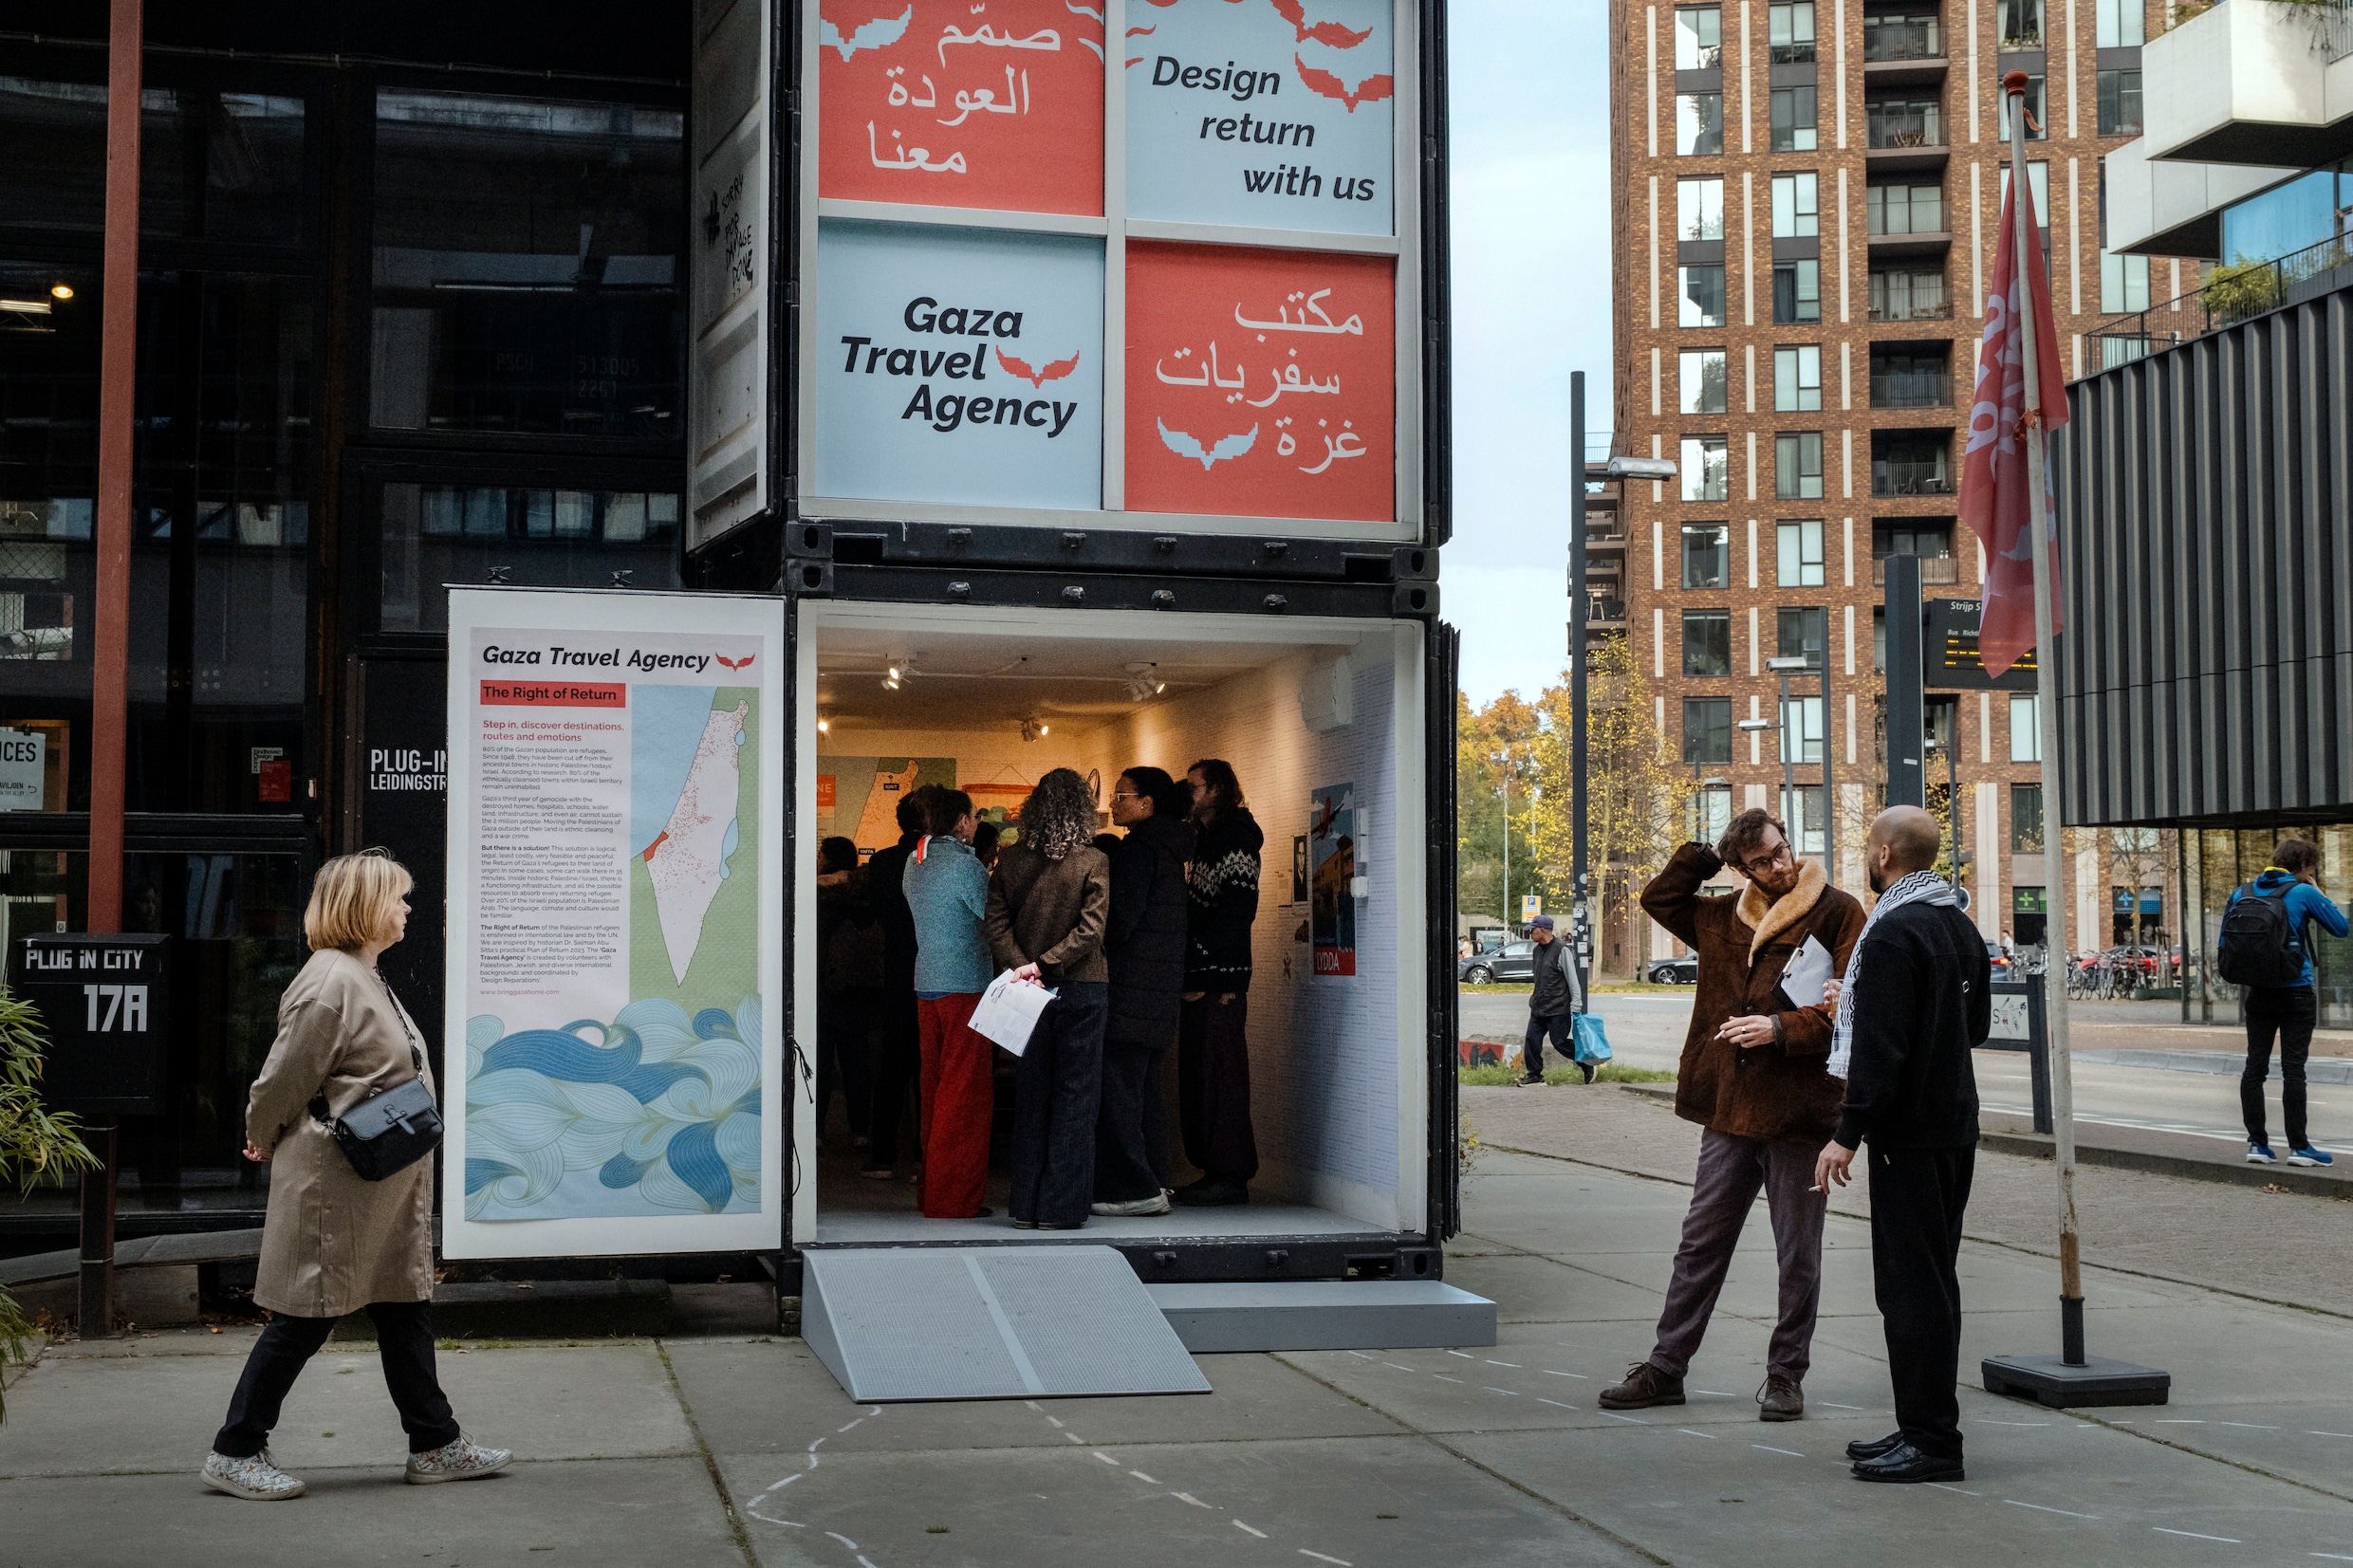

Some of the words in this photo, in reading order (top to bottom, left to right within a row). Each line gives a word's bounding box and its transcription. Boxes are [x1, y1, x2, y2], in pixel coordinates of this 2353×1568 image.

[1153, 56, 1281, 101] Design
[868, 121, 967, 175] معنا
[1200, 113, 1315, 147] return
[1244, 165, 1323, 197] with
[1333, 175, 1375, 201] us
[904, 296, 1023, 339] Gaza
[1234, 287, 1363, 343] مكتب
[841, 336, 987, 379] Travel
[1156, 341, 1341, 408] سفريات
[902, 384, 1078, 437] Agency
[1275, 415, 1368, 475] غزة
[1950, 601, 1974, 612] Strijp
[482, 646, 541, 664] Gaza
[550, 647, 619, 666] Travel
[627, 649, 710, 673] Agency
[483, 686, 510, 699] The
[513, 687, 550, 701] Right
[553, 687, 568, 700] of
[571, 688, 617, 701] Return
[482, 720, 506, 732] Step
[508, 721, 519, 731] in,
[521, 721, 562, 731] discover
[563, 721, 624, 732] destinations,
[482, 732, 512, 741] routes
[514, 733, 535, 741] and
[537, 733, 582, 742] emotions
[26, 949, 73, 969] PLUG
[83, 984, 148, 1032] 17A
